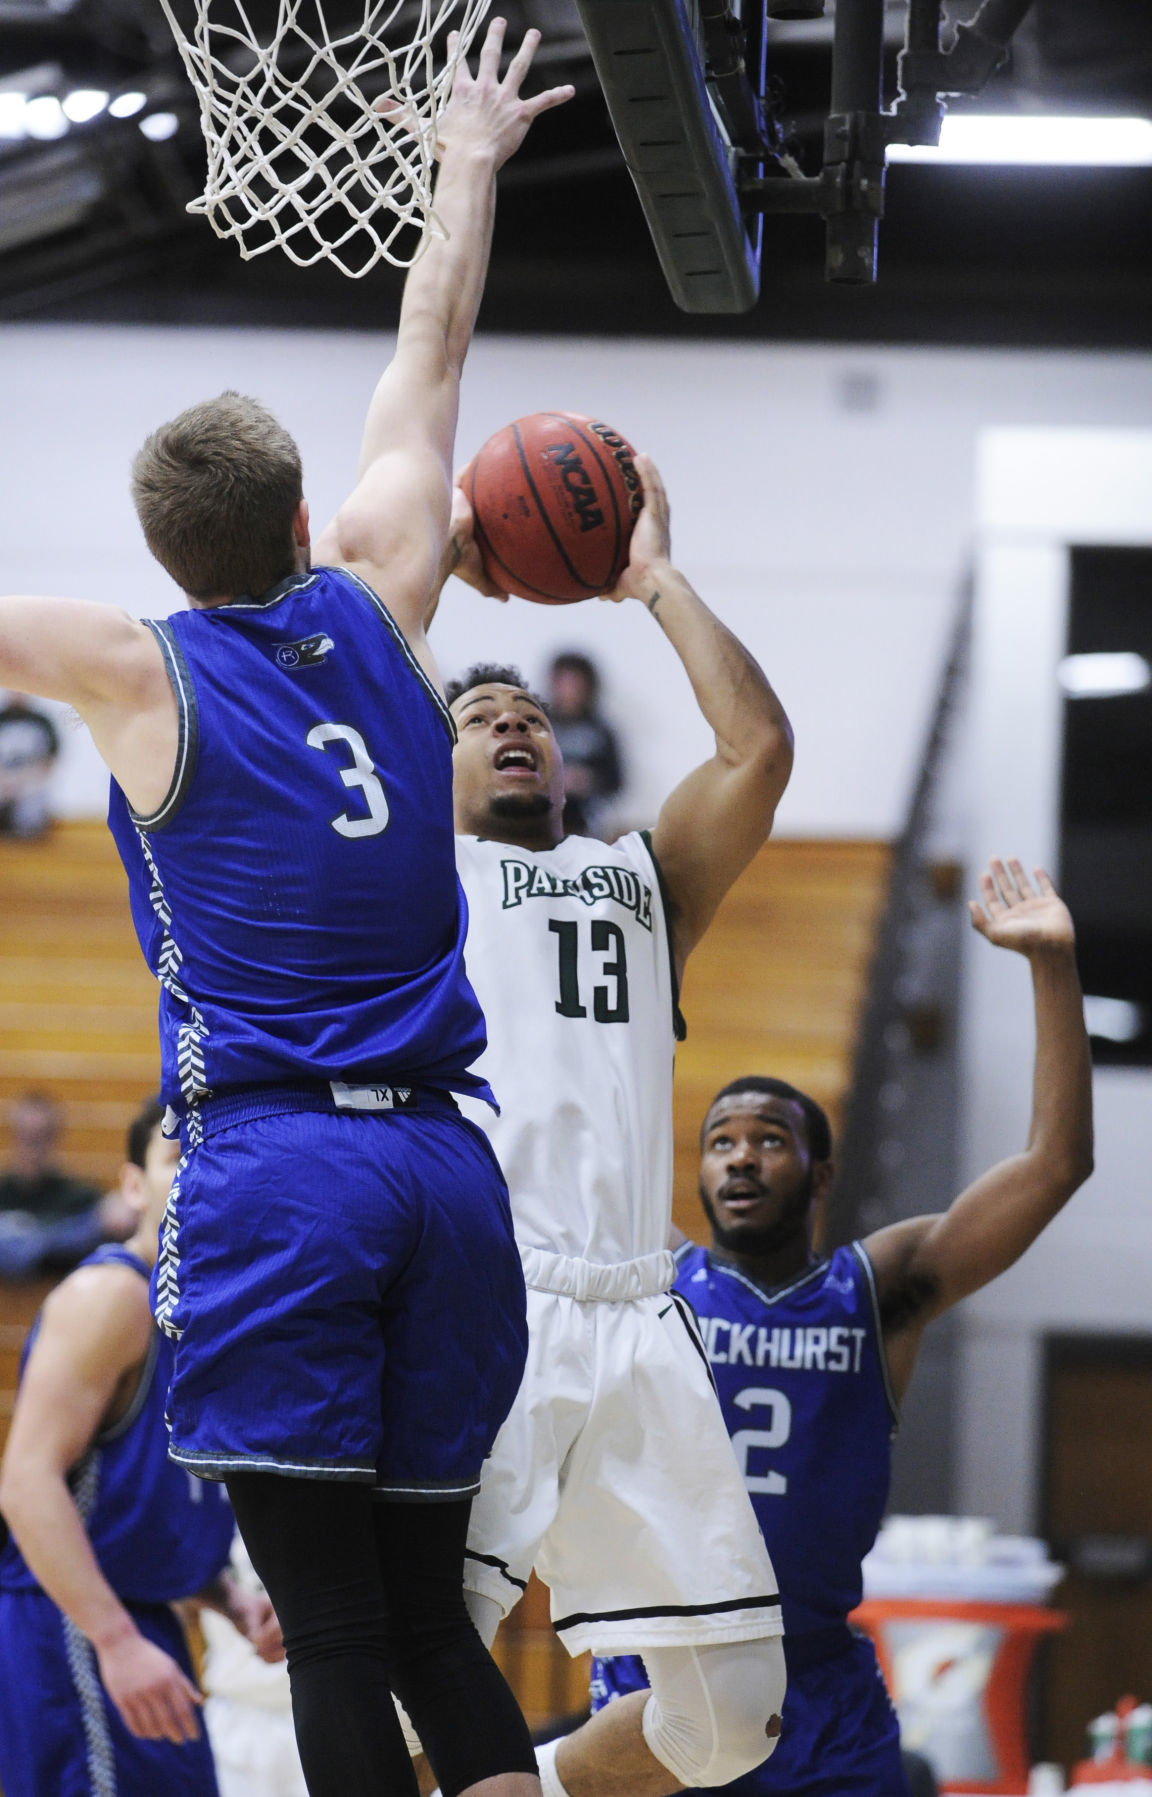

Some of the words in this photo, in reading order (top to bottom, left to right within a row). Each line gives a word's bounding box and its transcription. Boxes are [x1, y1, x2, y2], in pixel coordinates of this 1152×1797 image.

[548, 442, 605, 533] NCAA
[587, 422, 645, 518] Wilso
[306, 723, 389, 838] 3
[549, 918, 629, 1023] 13
[370, 1088, 389, 1102] XL
[697, 1316, 866, 1374] CKHURST
[731, 1387, 791, 1495] 2
